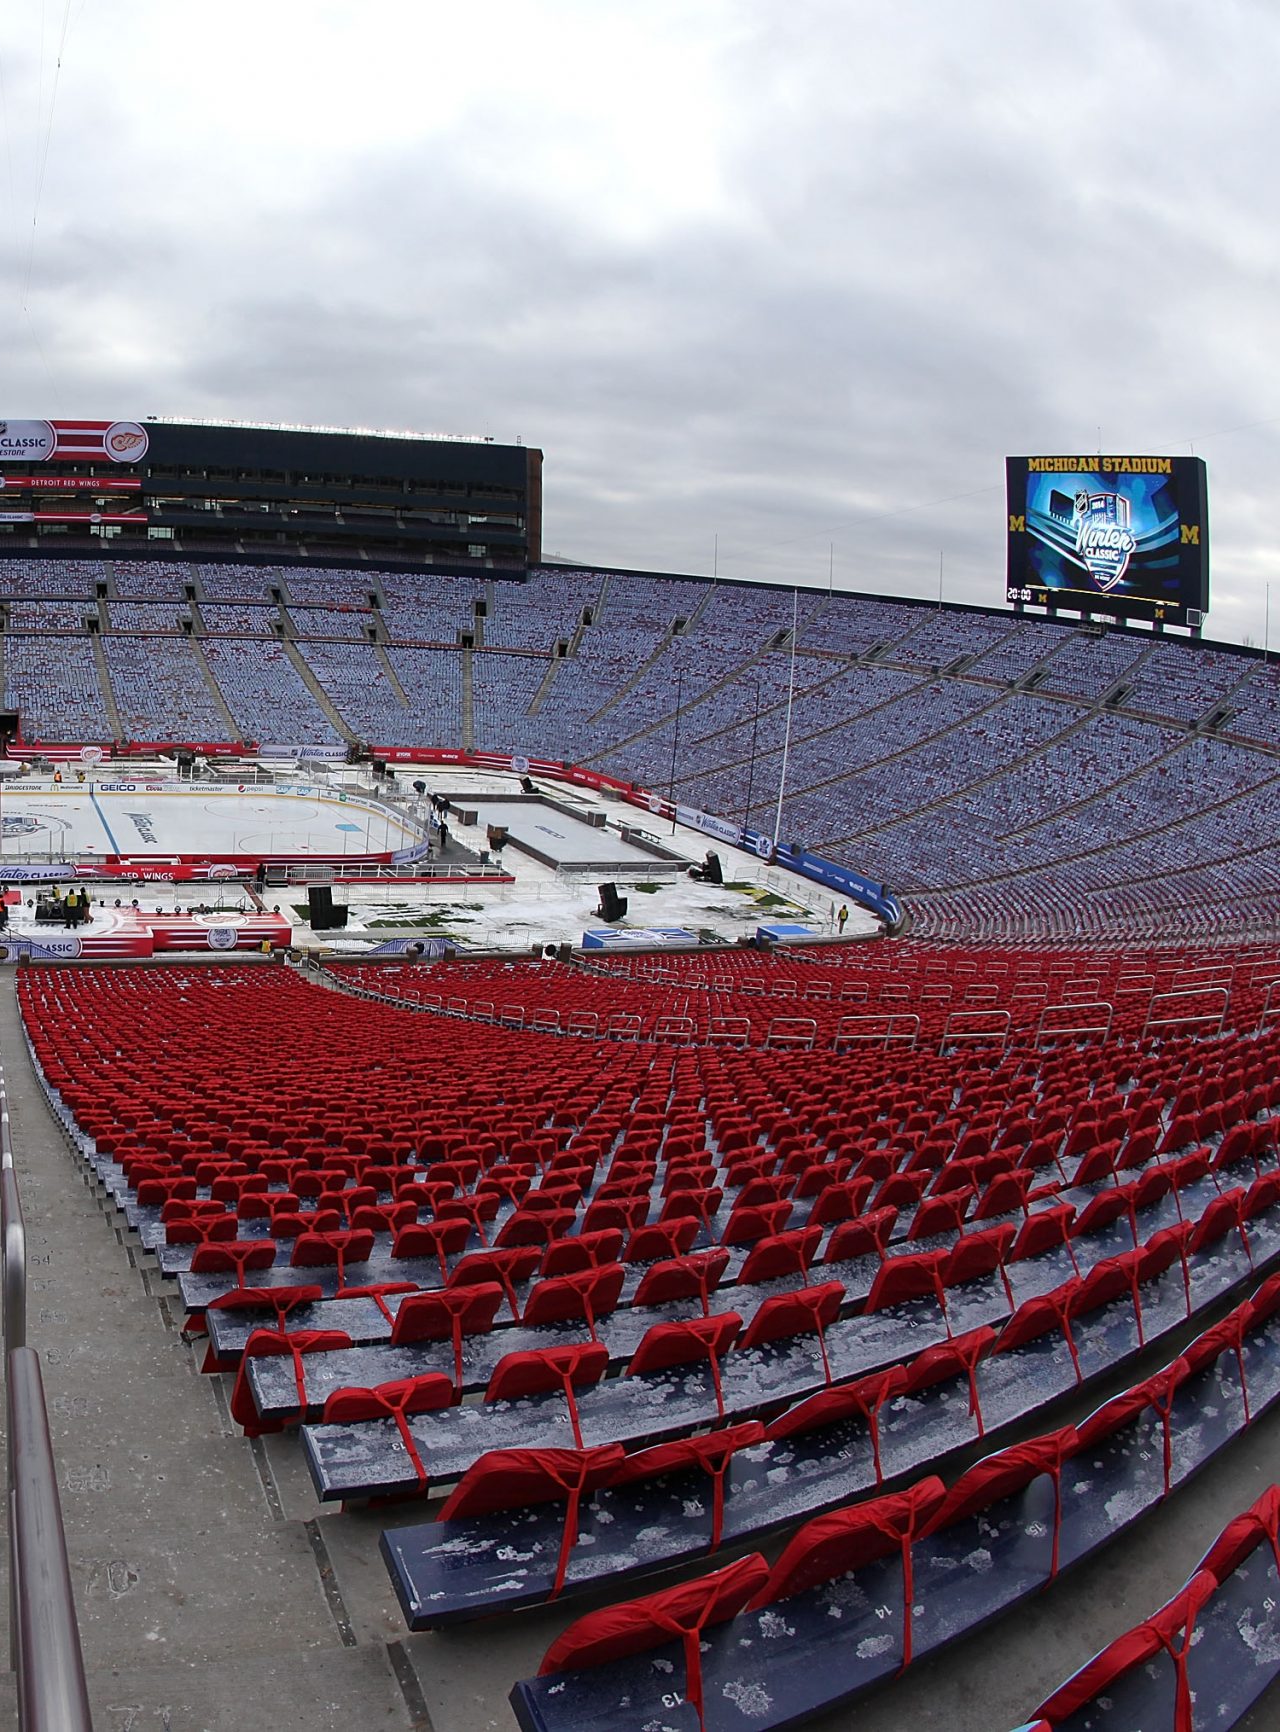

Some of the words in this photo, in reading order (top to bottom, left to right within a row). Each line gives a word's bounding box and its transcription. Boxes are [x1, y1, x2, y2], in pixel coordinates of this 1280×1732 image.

[1, 438, 46, 447] CLASSIC
[1028, 458, 1100, 472] MICHIGAN
[1102, 458, 1172, 473] STADIUM
[1009, 515, 1025, 532] M
[1076, 519, 1135, 555] Winter
[1180, 525, 1199, 544] M
[1085, 547, 1120, 561] CLASSIC
[1007, 588, 1032, 601] 20:00
[300, 747, 324, 757] Winter
[143, 872, 174, 880] WINGS
[322, 1372, 334, 1380] 13
[391, 1443, 406, 1451] 13
[838, 1449, 851, 1460] 15
[1139, 1450, 1151, 1460] 16
[690, 1499, 703, 1510] 14
[1029, 1522, 1042, 1533] 15
[1263, 1598, 1276, 1611] 15
[875, 1605, 893, 1619] 14
[661, 1692, 683, 1708] 13
